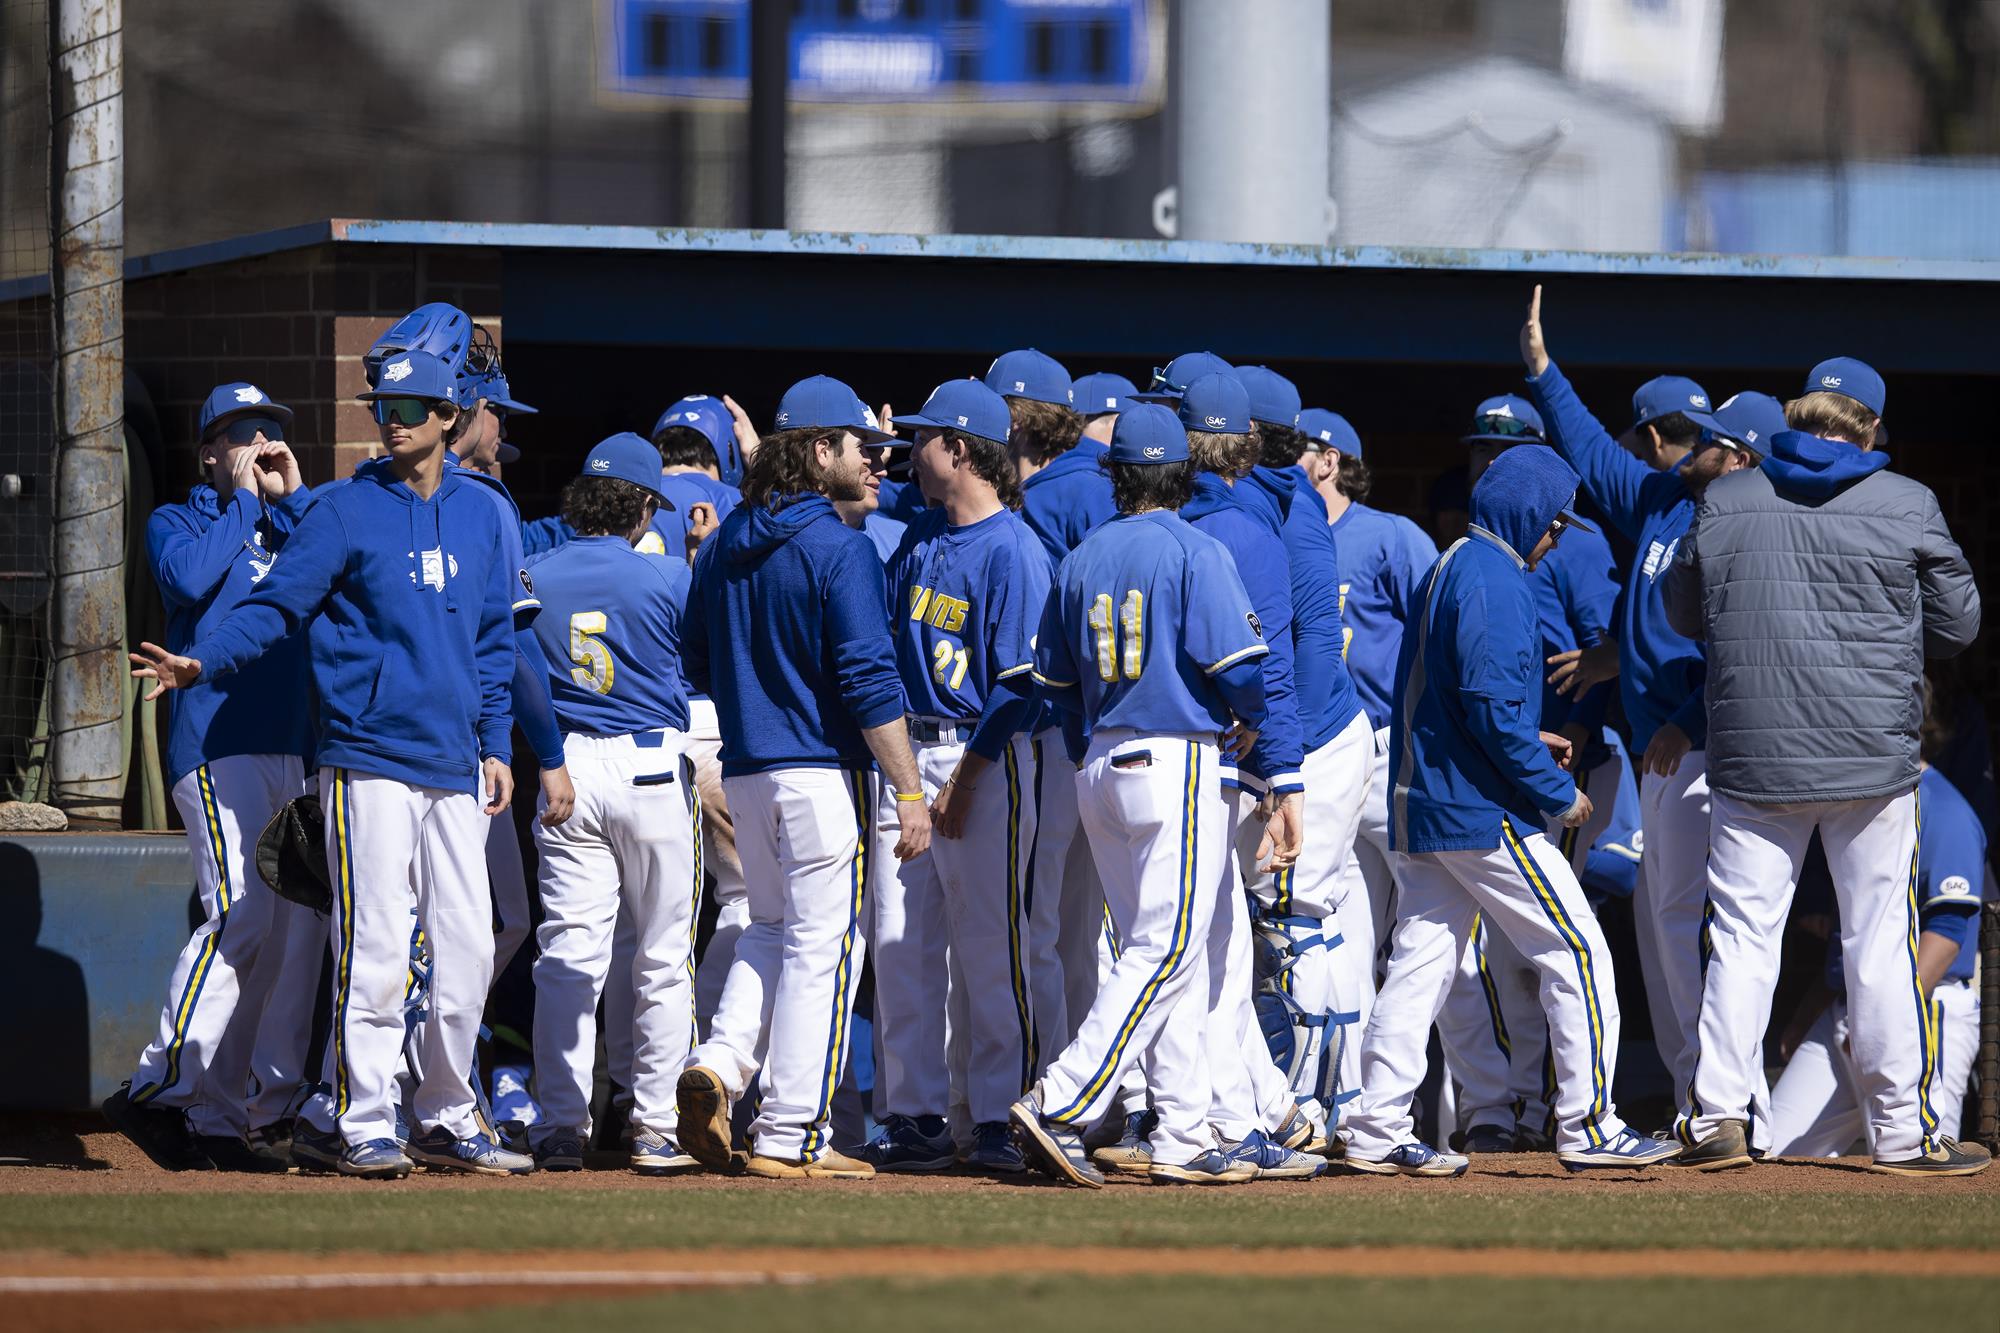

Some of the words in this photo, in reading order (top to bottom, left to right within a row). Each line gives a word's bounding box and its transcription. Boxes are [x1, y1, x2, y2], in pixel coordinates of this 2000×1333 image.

[1823, 376, 1841, 386] SAC
[1206, 416, 1226, 427] SAC
[1144, 447, 1165, 457] SAC
[592, 459, 610, 470] SAC
[1088, 589, 1142, 683] 11
[570, 610, 614, 695] 5
[933, 640, 971, 690] 21
